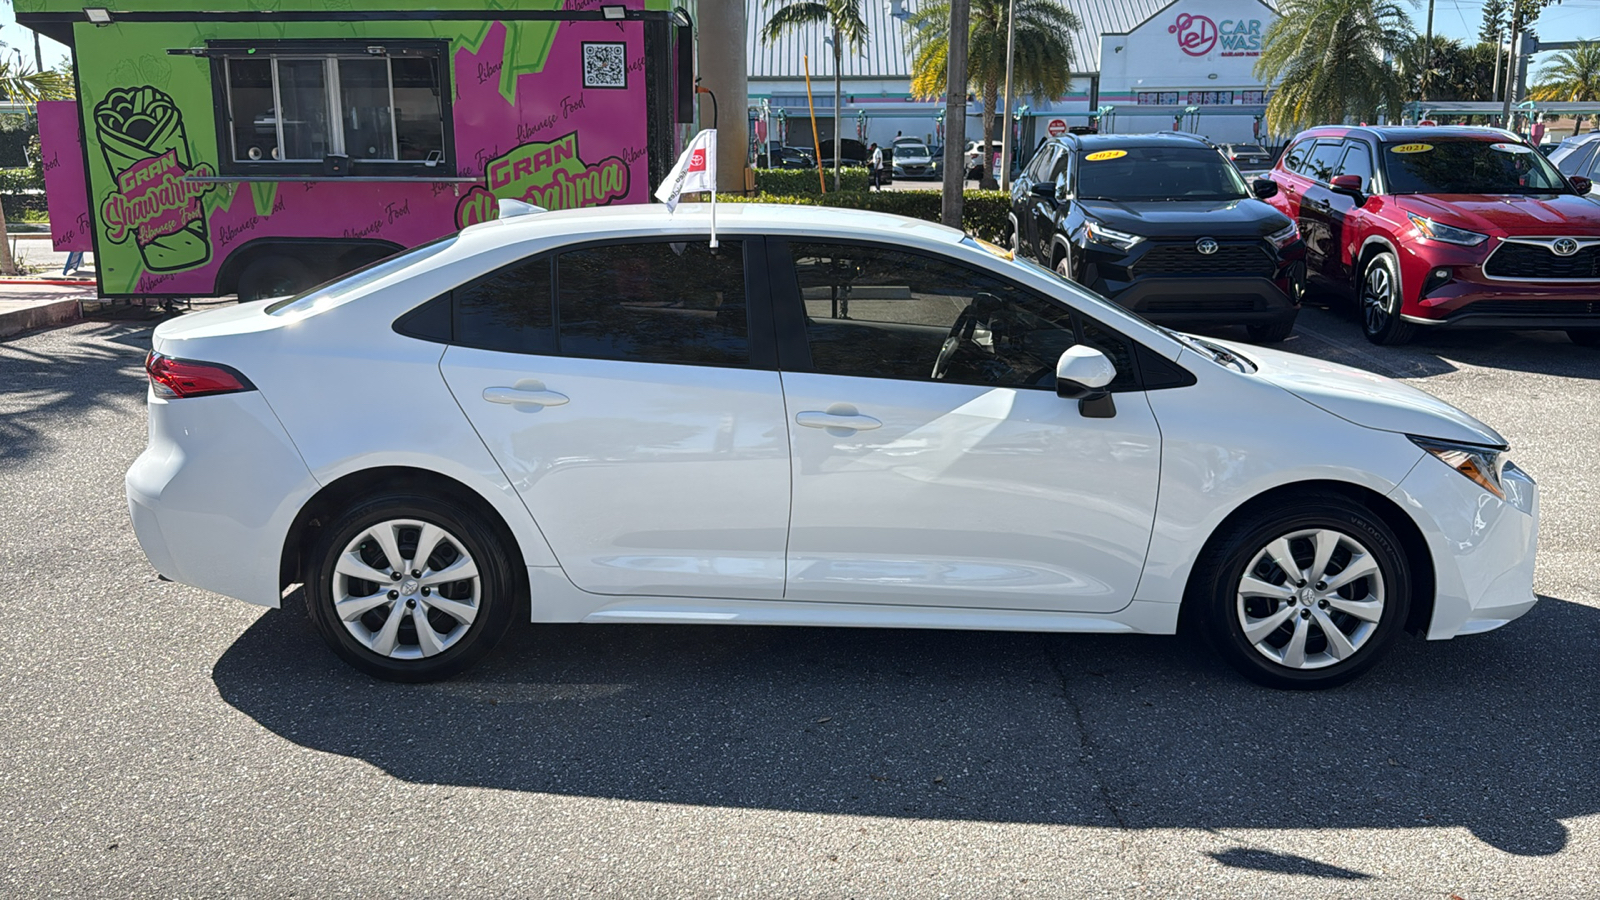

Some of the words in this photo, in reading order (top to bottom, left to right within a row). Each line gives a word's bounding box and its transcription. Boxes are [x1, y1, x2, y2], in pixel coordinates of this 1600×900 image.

[1218, 20, 1262, 35] CAR
[1219, 35, 1267, 51] WAS
[515, 114, 558, 145] Libanese
[560, 92, 586, 119] Food
[43, 151, 61, 171] ood
[1092, 151, 1120, 160] 2024
[1400, 144, 1425, 152] 2021
[120, 153, 178, 194] GRAN
[490, 139, 574, 191] GRAN
[105, 166, 211, 239] Shawarma
[179, 200, 203, 226] Food
[384, 198, 411, 225] Food
[219, 215, 259, 247] Libanese
